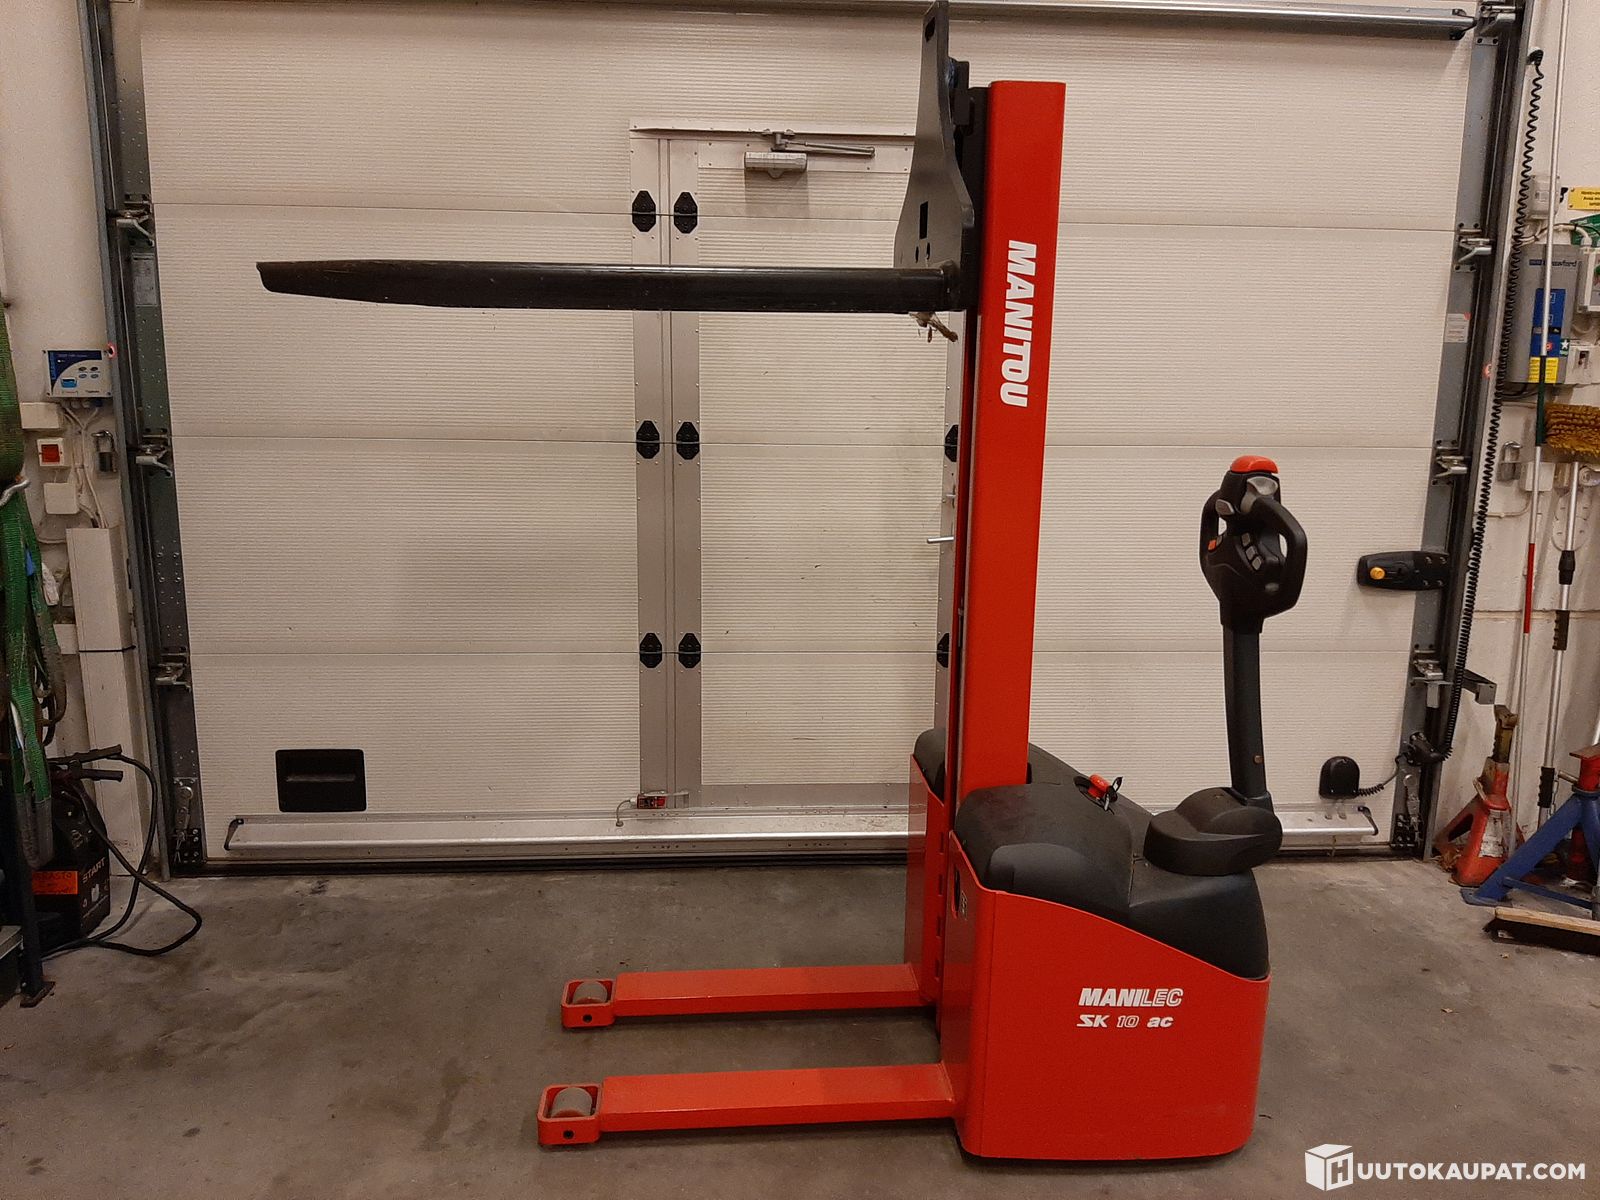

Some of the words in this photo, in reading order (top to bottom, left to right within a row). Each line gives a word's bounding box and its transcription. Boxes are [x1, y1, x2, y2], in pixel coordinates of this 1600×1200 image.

[1000, 240, 1037, 407] MANITOU
[82, 856, 105, 884] START
[1078, 987, 1184, 1007] MANILEC
[1077, 1014, 1110, 1028] SK
[1116, 1015, 1140, 1028] 10
[1146, 1016, 1174, 1028] ac
